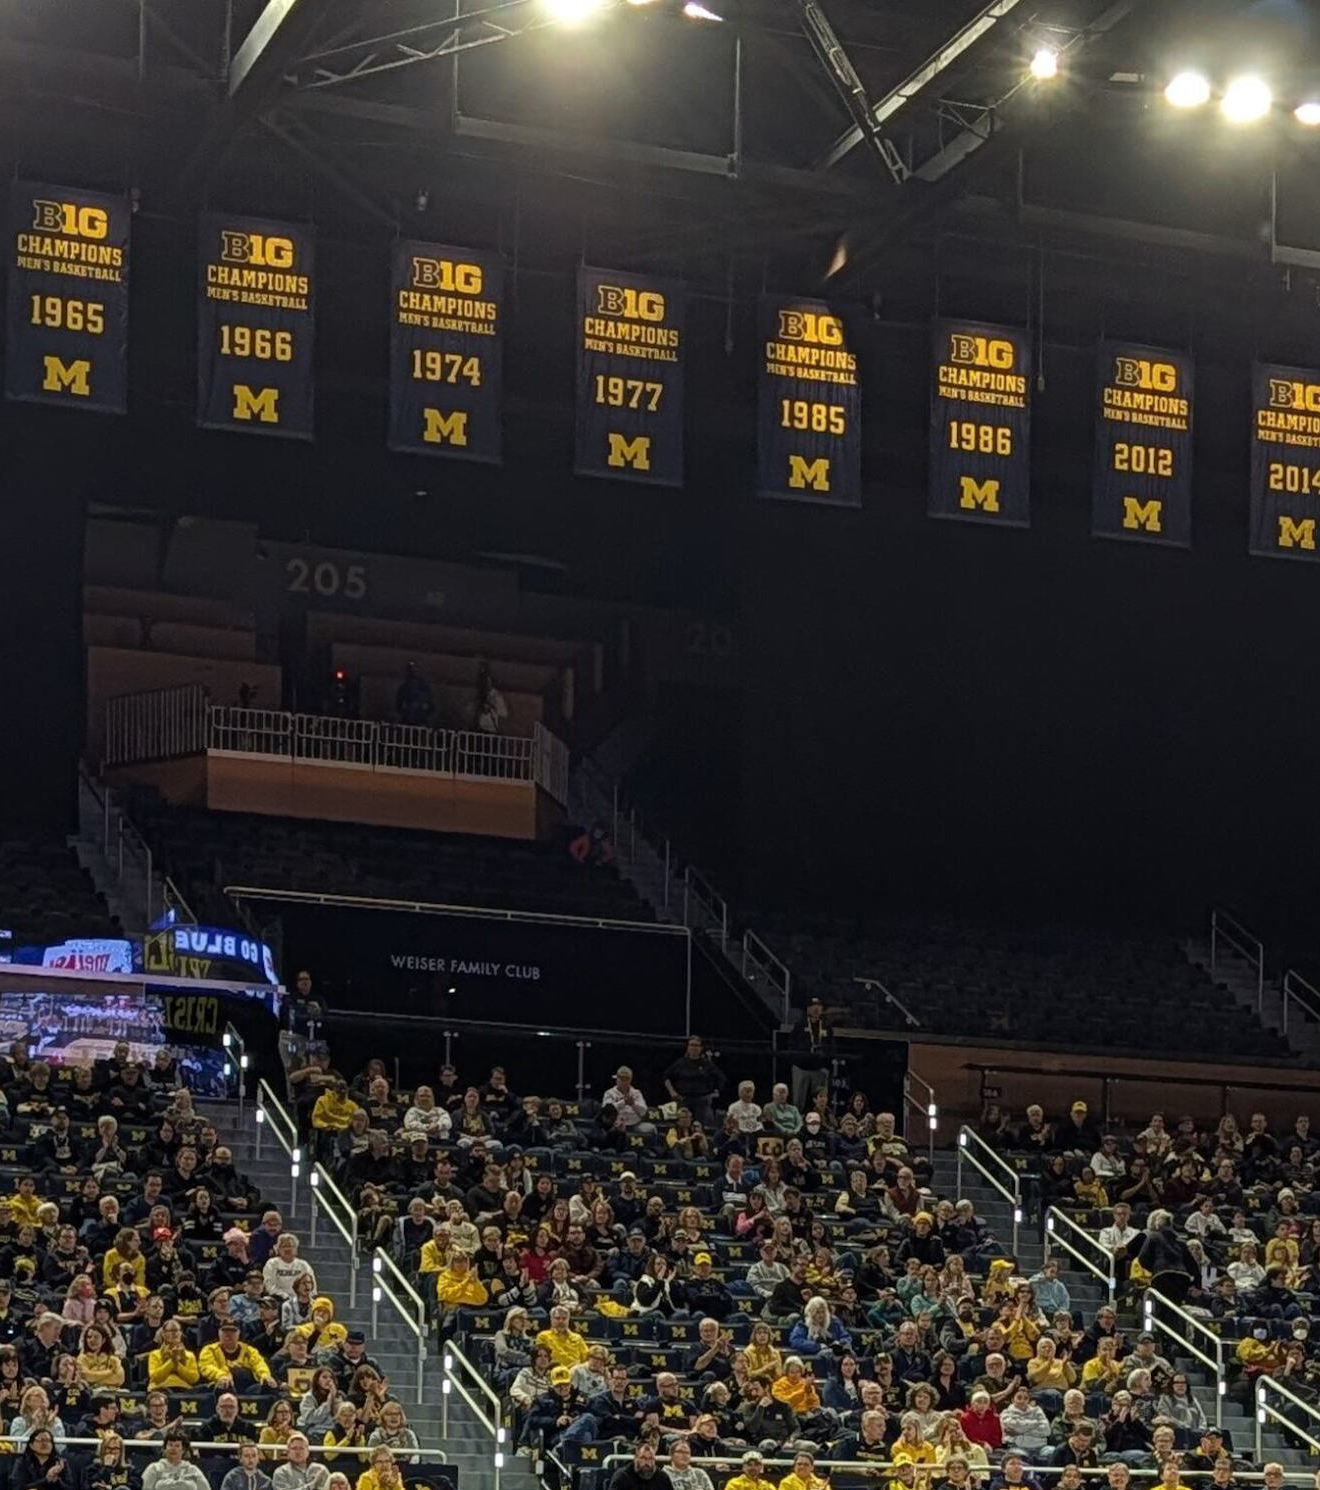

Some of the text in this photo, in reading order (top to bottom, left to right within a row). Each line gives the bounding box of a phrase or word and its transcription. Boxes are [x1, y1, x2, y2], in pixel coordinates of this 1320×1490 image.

[17, 235, 122, 267] CHAMPIONS
[210, 265, 309, 297] CHAMPIONS
[32, 295, 105, 336] 1965
[400, 290, 497, 322] CHAMPIONS
[221, 325, 293, 361] 1966
[583, 317, 677, 347] CHAMPIONS
[413, 349, 481, 386] 1974
[766, 341, 857, 372] CHAMPIONS
[44, 356, 90, 395] M
[596, 376, 662, 410] 1977
[940, 365, 1025, 396] CHAMPIONS
[233, 385, 278, 422] M
[782, 400, 845, 435] 1985
[1104, 388, 1188, 418] CHAMPIONS
[424, 409, 467, 445] M
[950, 421, 1012, 456] 1986
[608, 433, 649, 469] M
[1113, 442, 1173, 477] 2012
[790, 456, 829, 491] M
[961, 476, 998, 512] M
[1124, 497, 1161, 531] M
[1279, 516, 1315, 549] M
[285, 558, 368, 600] 205
[390, 954, 541, 980] WEISER FAMILY CLUB
